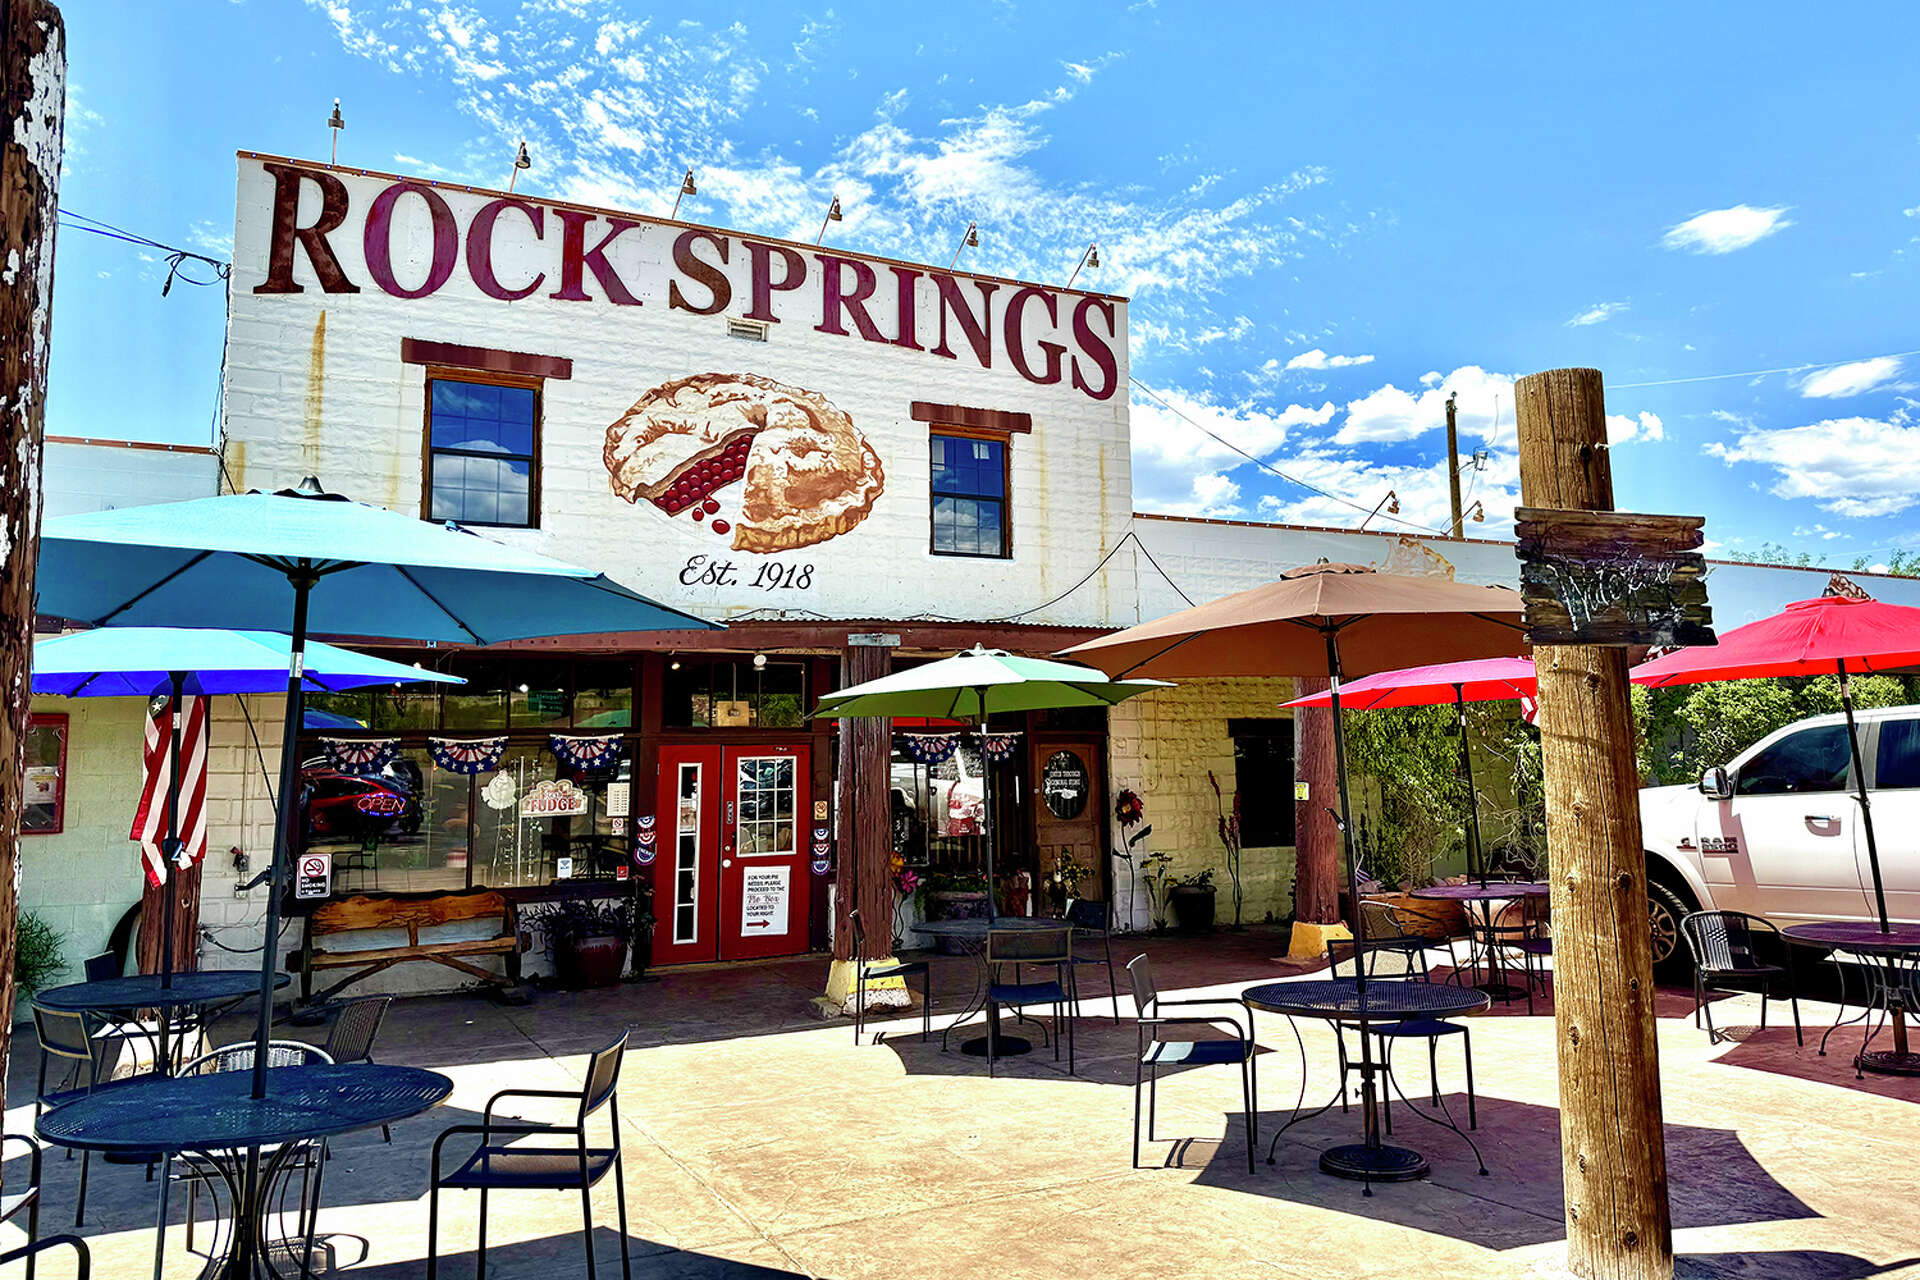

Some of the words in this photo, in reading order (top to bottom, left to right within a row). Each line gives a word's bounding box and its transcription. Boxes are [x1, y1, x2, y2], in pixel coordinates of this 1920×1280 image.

[253, 162, 643, 306] ROCK
[669, 230, 1118, 400] SPRINGS
[679, 554, 738, 586] Est.
[748, 561, 815, 592] 1918
[357, 797, 407, 812] OPEN
[531, 797, 576, 812] FUDGE
